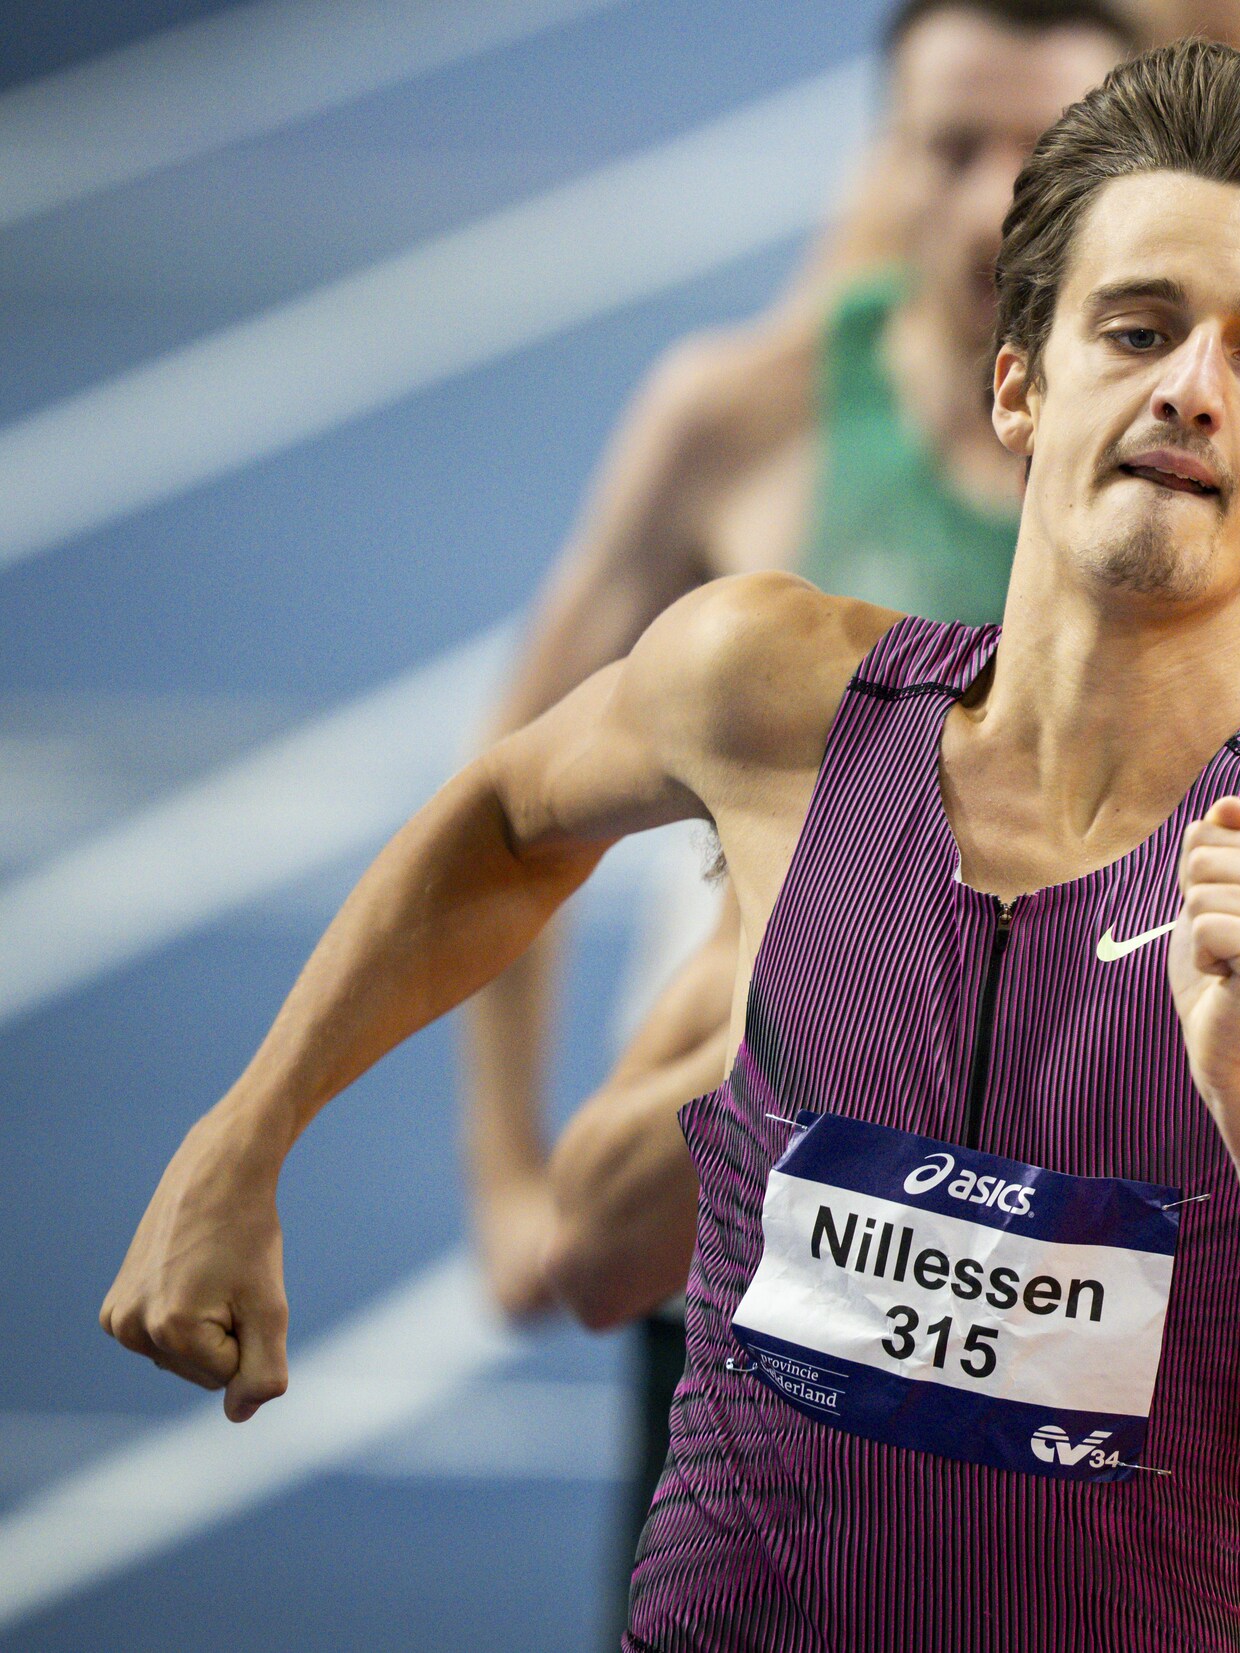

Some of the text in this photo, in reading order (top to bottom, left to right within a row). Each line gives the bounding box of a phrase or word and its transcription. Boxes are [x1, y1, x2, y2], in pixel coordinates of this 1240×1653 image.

[810, 1204, 1105, 1323] Nillessen
[760, 1353, 819, 1381] provincie
[881, 1304, 999, 1378] 315
